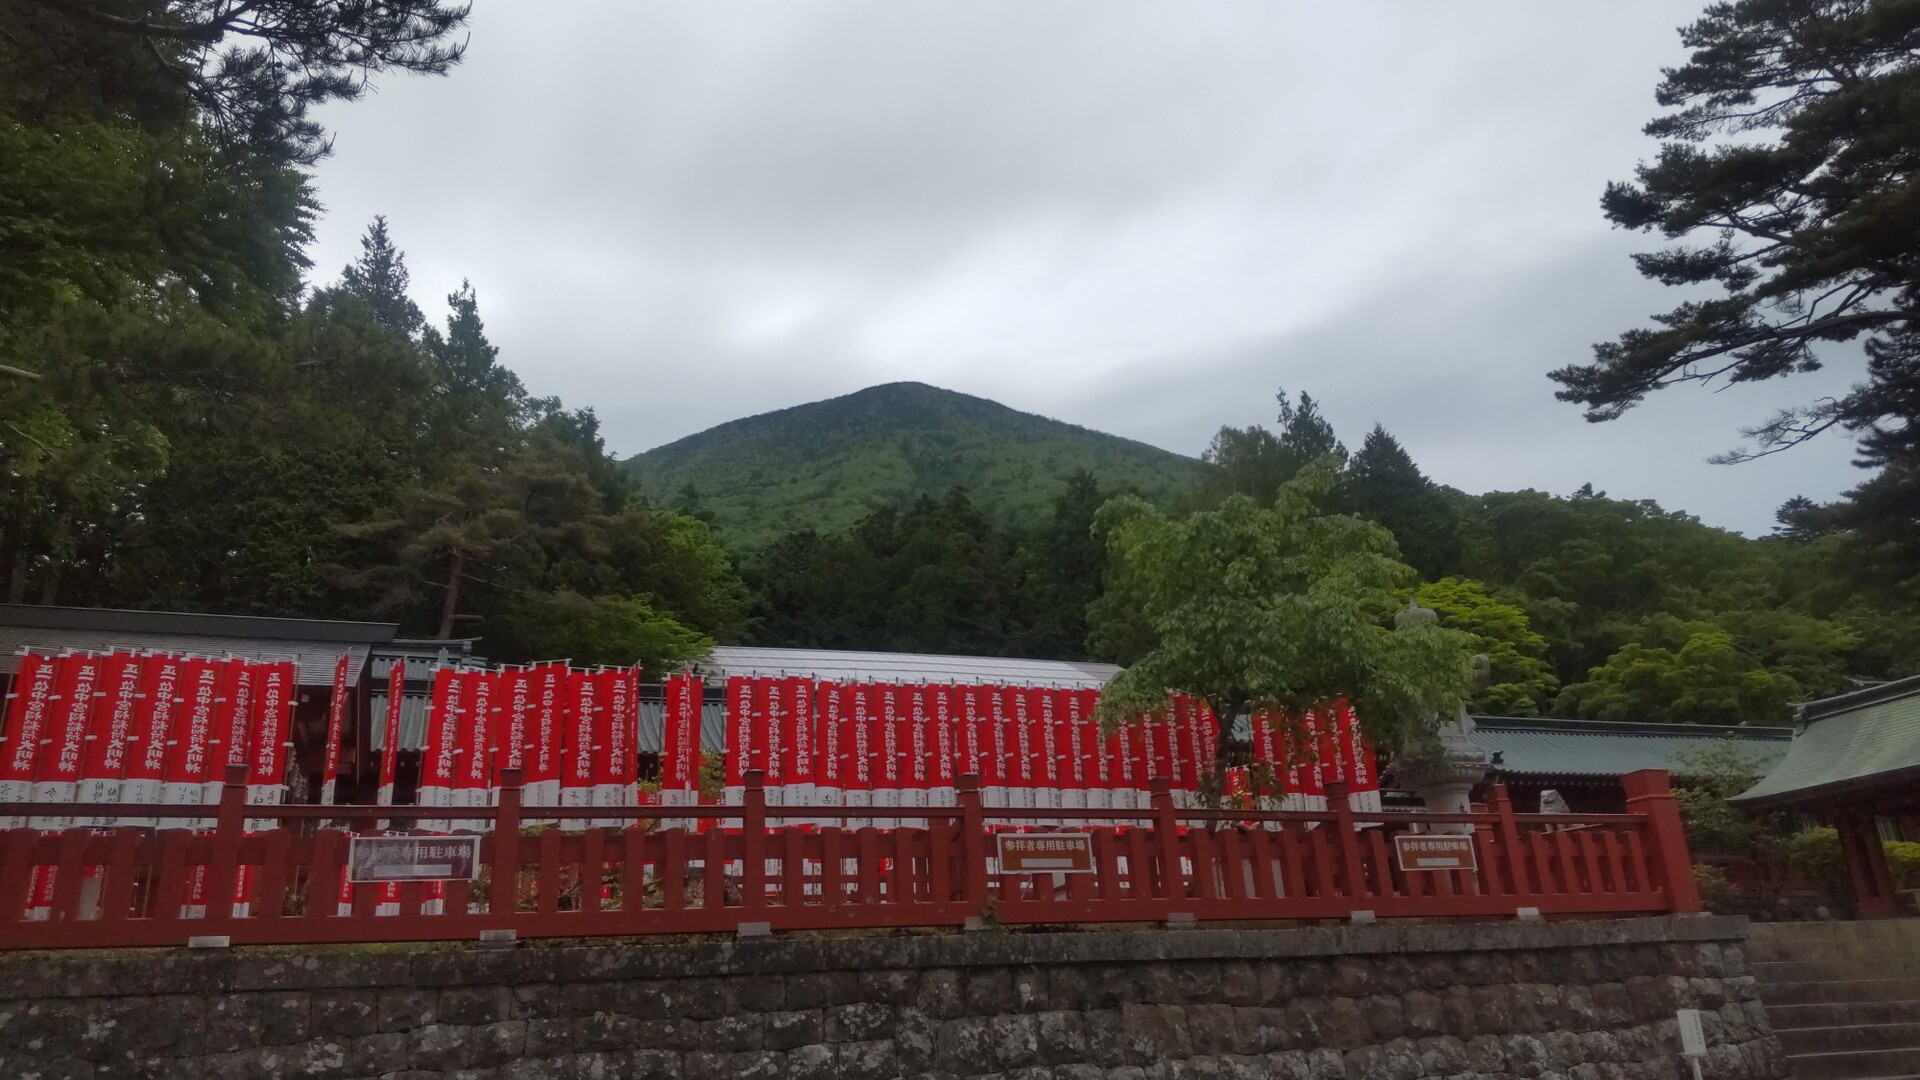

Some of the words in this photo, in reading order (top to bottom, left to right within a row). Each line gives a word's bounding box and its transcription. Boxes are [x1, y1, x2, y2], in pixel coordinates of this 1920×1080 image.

[1005, 840, 1086, 851] 参拝者専用駐車場
